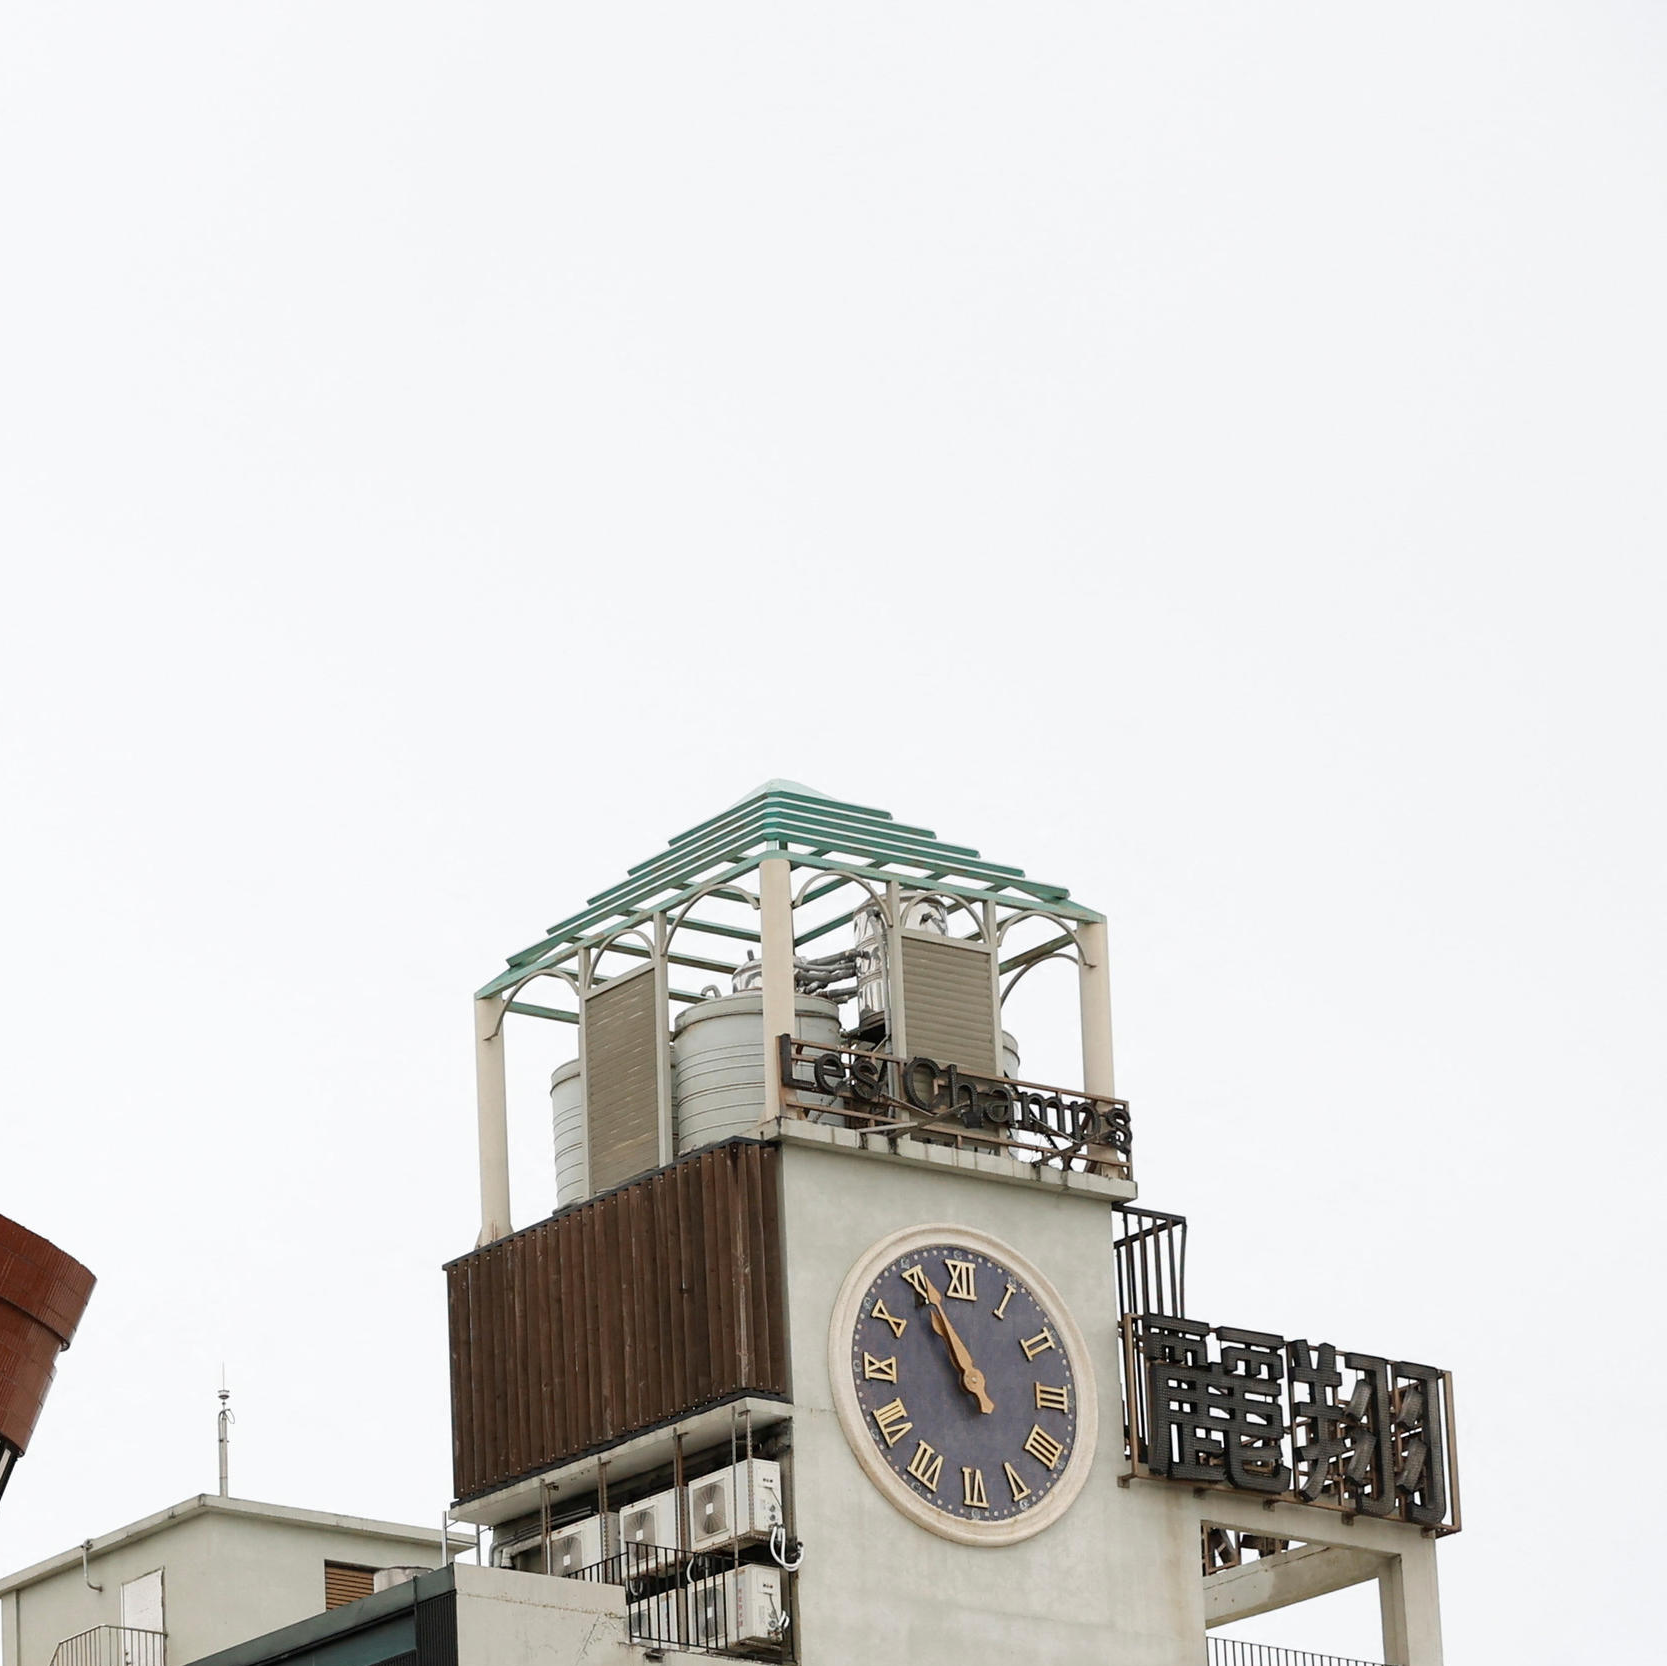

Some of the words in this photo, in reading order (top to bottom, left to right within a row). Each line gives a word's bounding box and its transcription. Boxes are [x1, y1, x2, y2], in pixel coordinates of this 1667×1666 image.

[776, 1033, 882, 1100] Les
[945, 1258, 977, 1300] XII
[871, 1298, 907, 1338] X
[992, 1283, 1017, 1320] I
[1019, 1326, 1056, 1361] II
[863, 1351, 898, 1384] IX
[1034, 1381, 1068, 1414] III
[961, 1466, 989, 1509] VI
[1003, 1461, 1032, 1501] V
